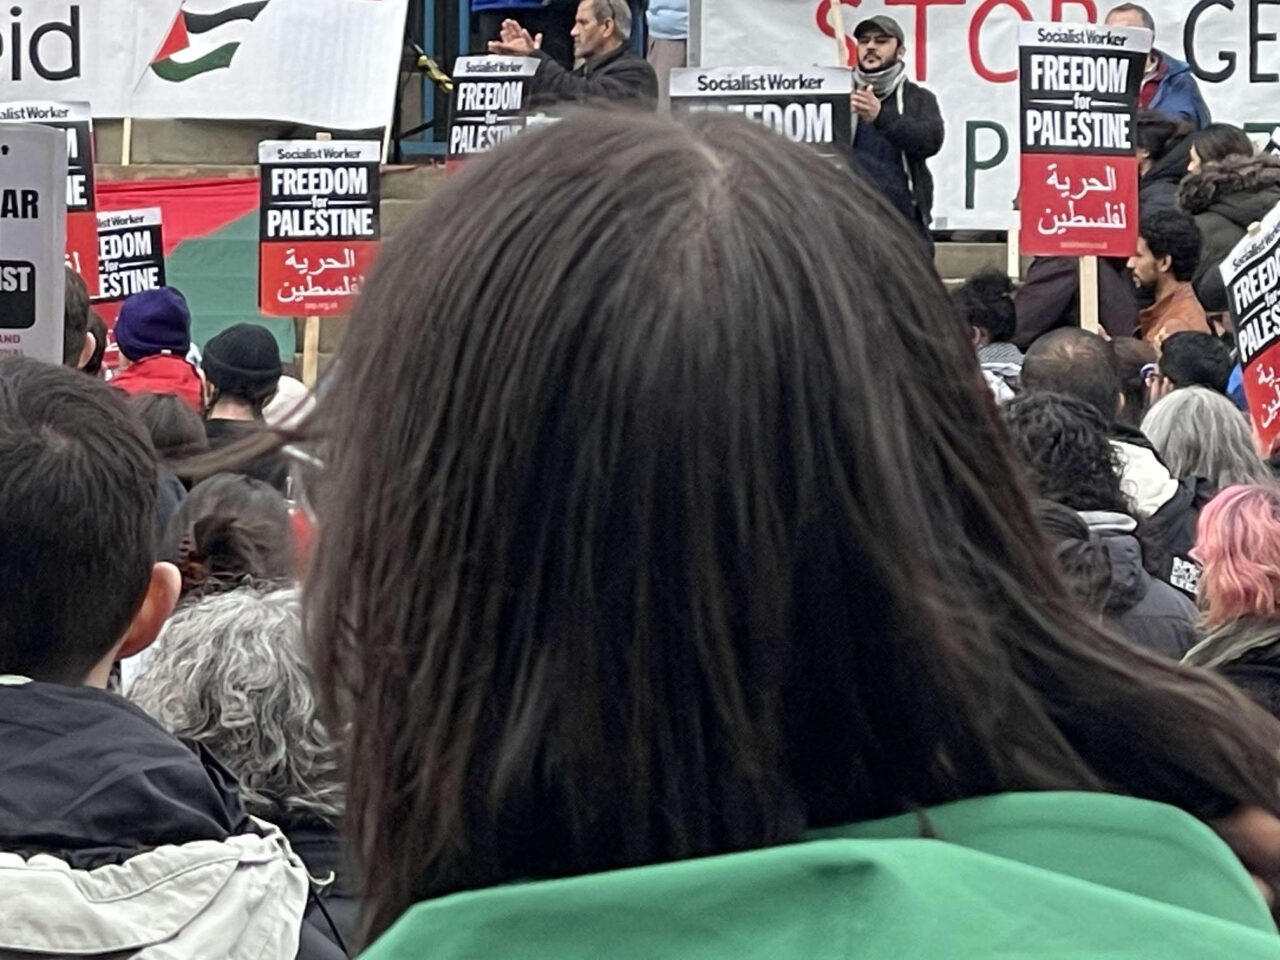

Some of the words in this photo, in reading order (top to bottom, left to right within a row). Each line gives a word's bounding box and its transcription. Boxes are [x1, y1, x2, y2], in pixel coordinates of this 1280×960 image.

[1038, 28, 1086, 45] Socialist
[1086, 30, 1128, 47] Worker
[697, 74, 766, 91] Socialist
[768, 73, 825, 90] Worker
[1030, 54, 1130, 93] FREEDOM
[457, 81, 523, 111] FREEDOM
[1073, 92, 1091, 110] for
[27, 105, 70, 120] Worker
[1026, 110, 1131, 149] PALESTINE
[277, 148, 321, 160] Socialist
[323, 147, 362, 160] Worker
[271, 167, 368, 196] FREEDOM
[1046, 163, 1117, 200] الحرية
[311, 195, 329, 208] for
[112, 215, 145, 227] Worker
[267, 208, 375, 237] PALESTINE
[1037, 200, 1127, 235] لفلسطين
[99, 230, 152, 260] EDOM
[104, 259, 120, 272] for
[285, 247, 356, 275] الحرية
[99, 267, 160, 299] ESTINE
